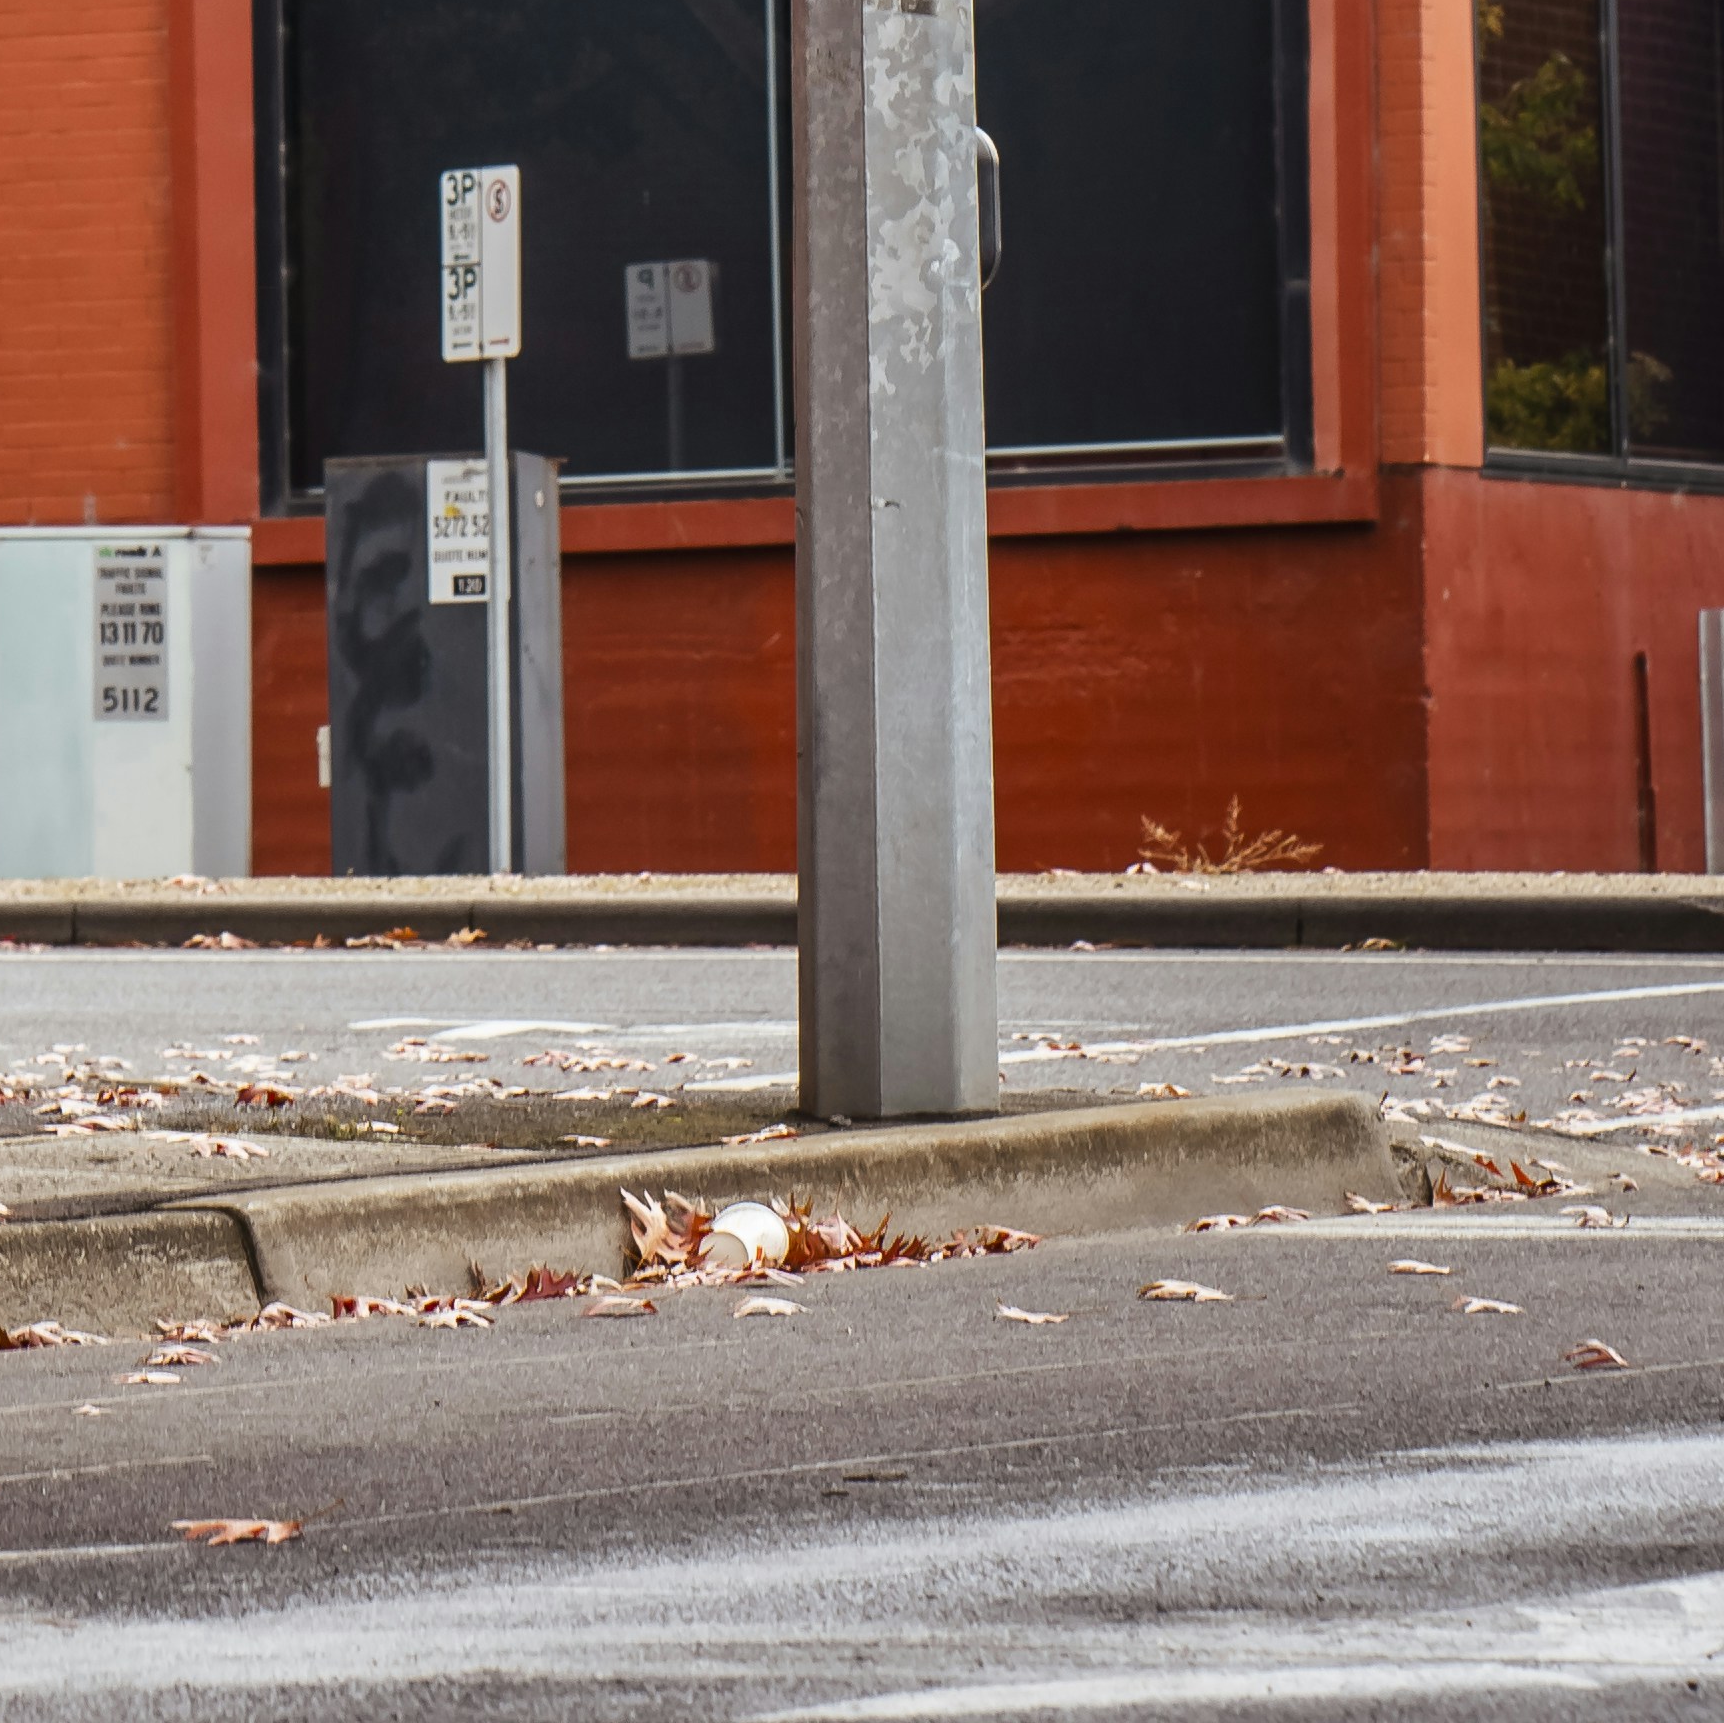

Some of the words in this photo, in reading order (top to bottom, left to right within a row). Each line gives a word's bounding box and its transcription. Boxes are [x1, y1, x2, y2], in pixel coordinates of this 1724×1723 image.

[447, 172, 476, 207] 3P
[448, 268, 477, 301] 3P
[444, 491, 486, 502] FAULT
[100, 622, 118, 645] 13
[123, 622, 136, 645] 11
[142, 622, 164, 645] 70
[103, 686, 160, 713] 5112
